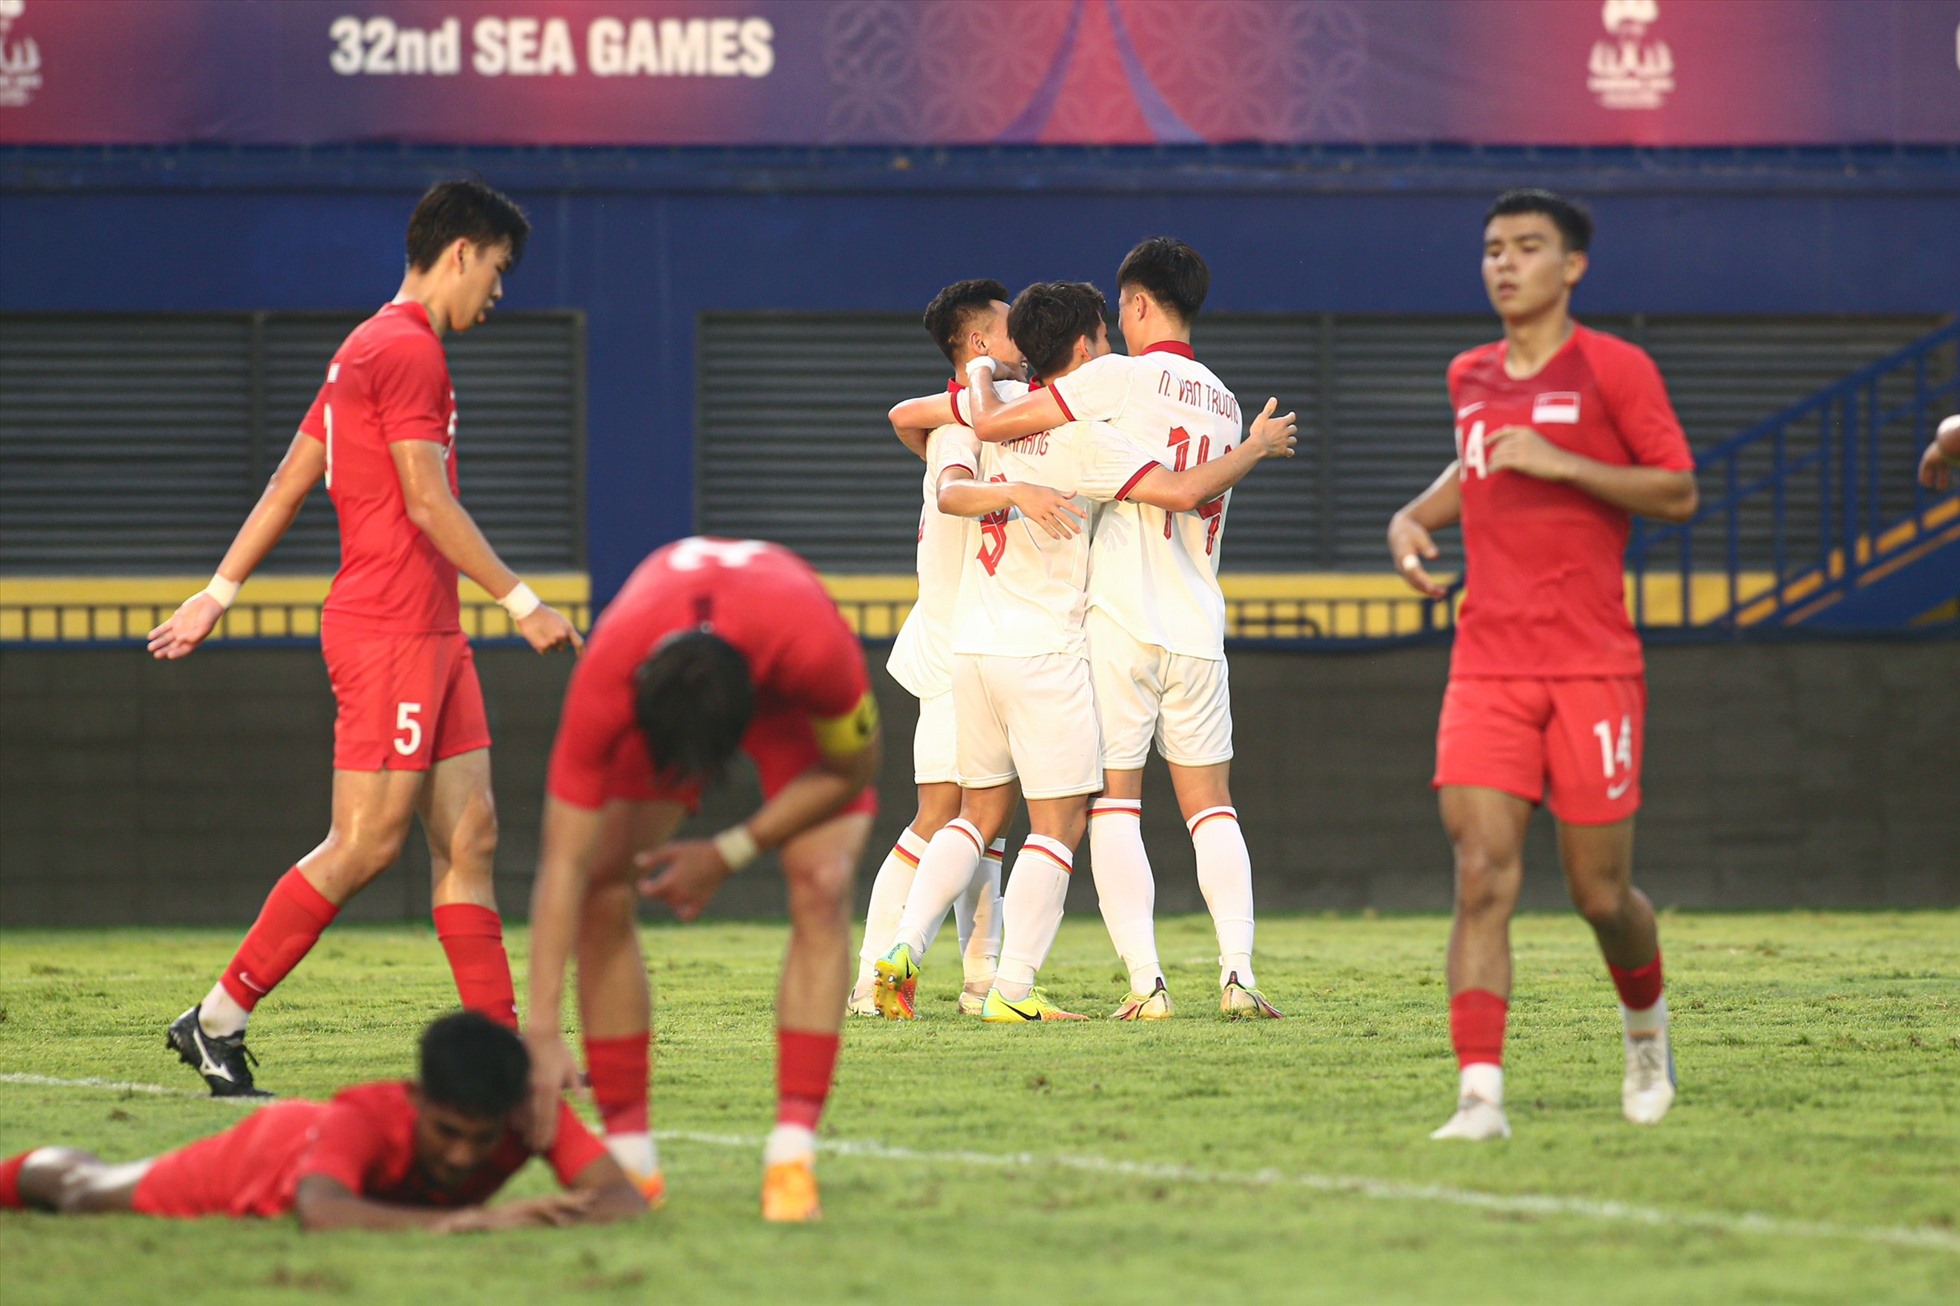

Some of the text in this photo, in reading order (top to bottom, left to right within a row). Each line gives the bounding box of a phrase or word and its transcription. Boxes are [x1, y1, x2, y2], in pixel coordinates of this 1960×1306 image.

[329, 18, 775, 77] 32nd SEA GAMES
[1176, 376, 1202, 408] VAN
[1455, 420, 1488, 482] 14
[393, 702, 422, 756] 5
[1593, 714, 1632, 779] 14
